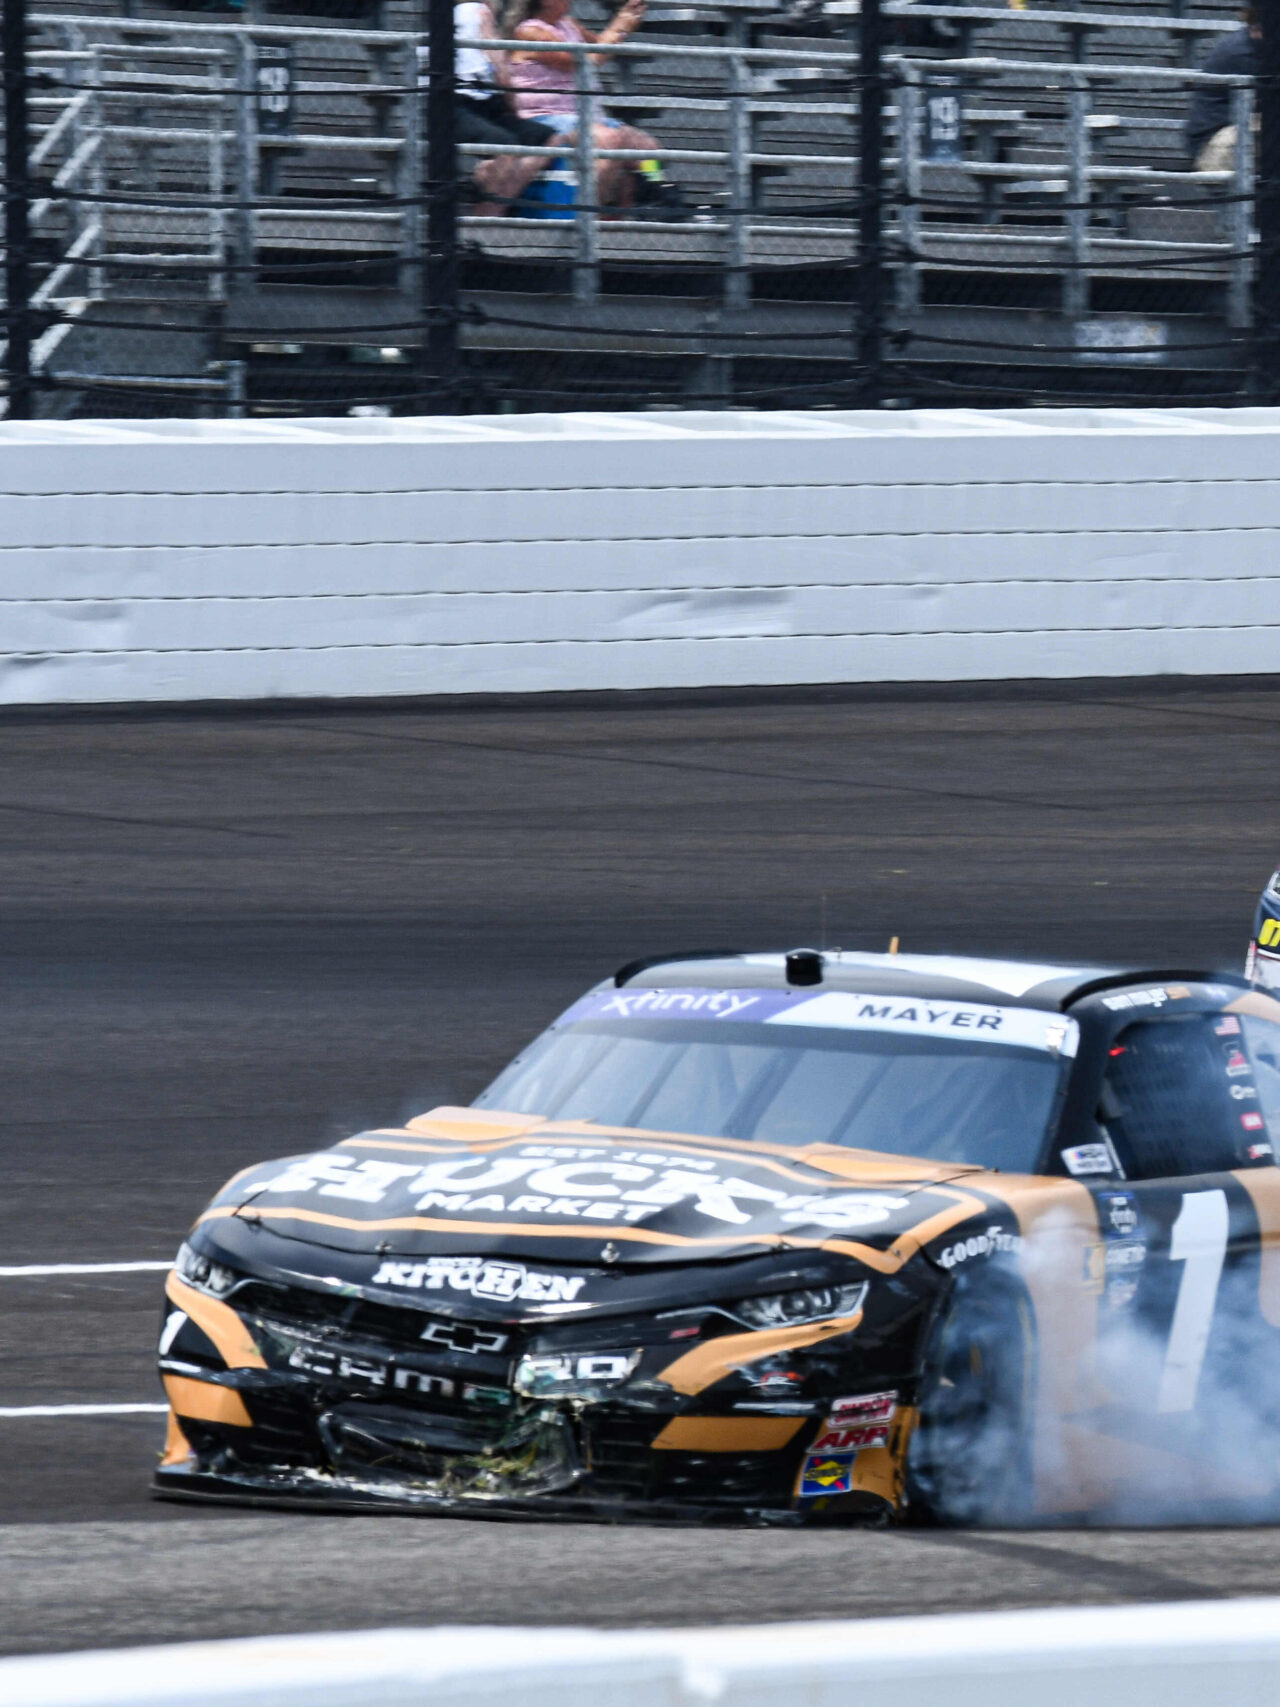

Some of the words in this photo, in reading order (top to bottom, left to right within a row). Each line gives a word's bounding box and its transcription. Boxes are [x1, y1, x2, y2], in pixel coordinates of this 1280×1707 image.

[600, 990, 761, 1018] xfinity
[857, 1003, 1004, 1031] MAYER
[415, 1191, 662, 1222] MARKET
[372, 1260, 586, 1302] KITCHEN
[1157, 1188, 1230, 1415] 1
[814, 1426, 890, 1449] ARP
